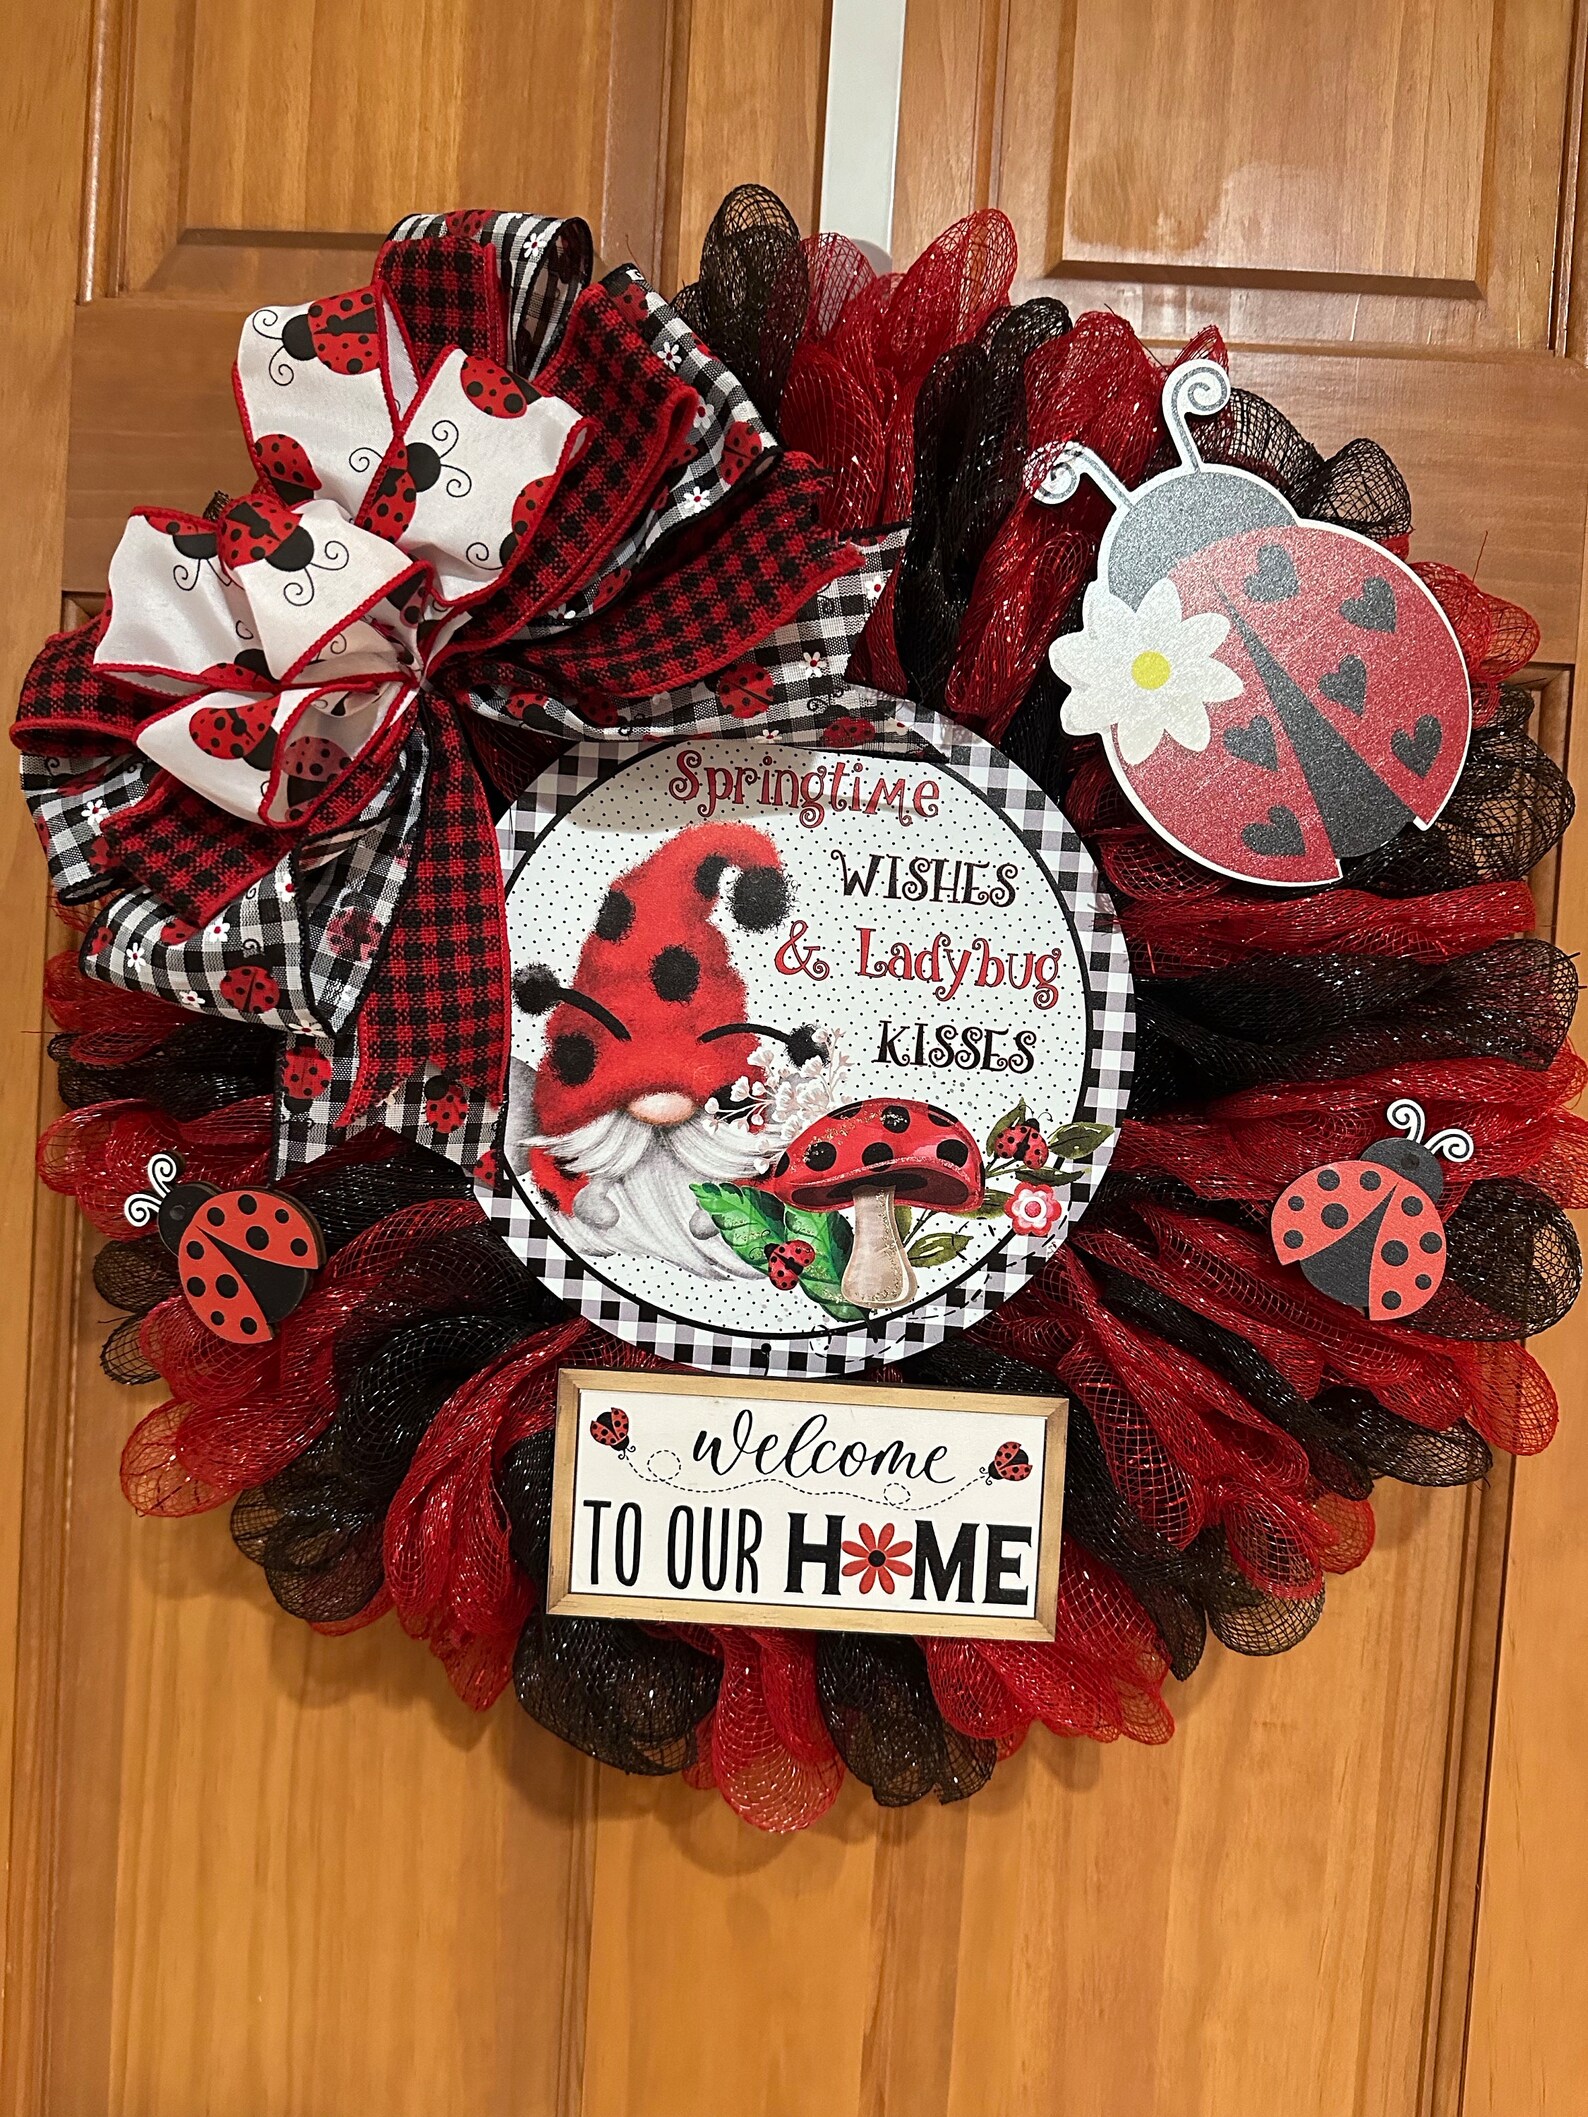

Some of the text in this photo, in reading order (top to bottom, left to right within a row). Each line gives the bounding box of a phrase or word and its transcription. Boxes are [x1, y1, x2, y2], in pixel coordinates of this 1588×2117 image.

[830, 849, 1019, 907] WISHES
[773, 920, 1062, 1010] & Ladybug
[871, 1020, 1037, 1074] KISSES
[692, 1409, 956, 1484] welcome
[583, 1500, 642, 1588] TO
[667, 1505, 763, 1594] OUR
